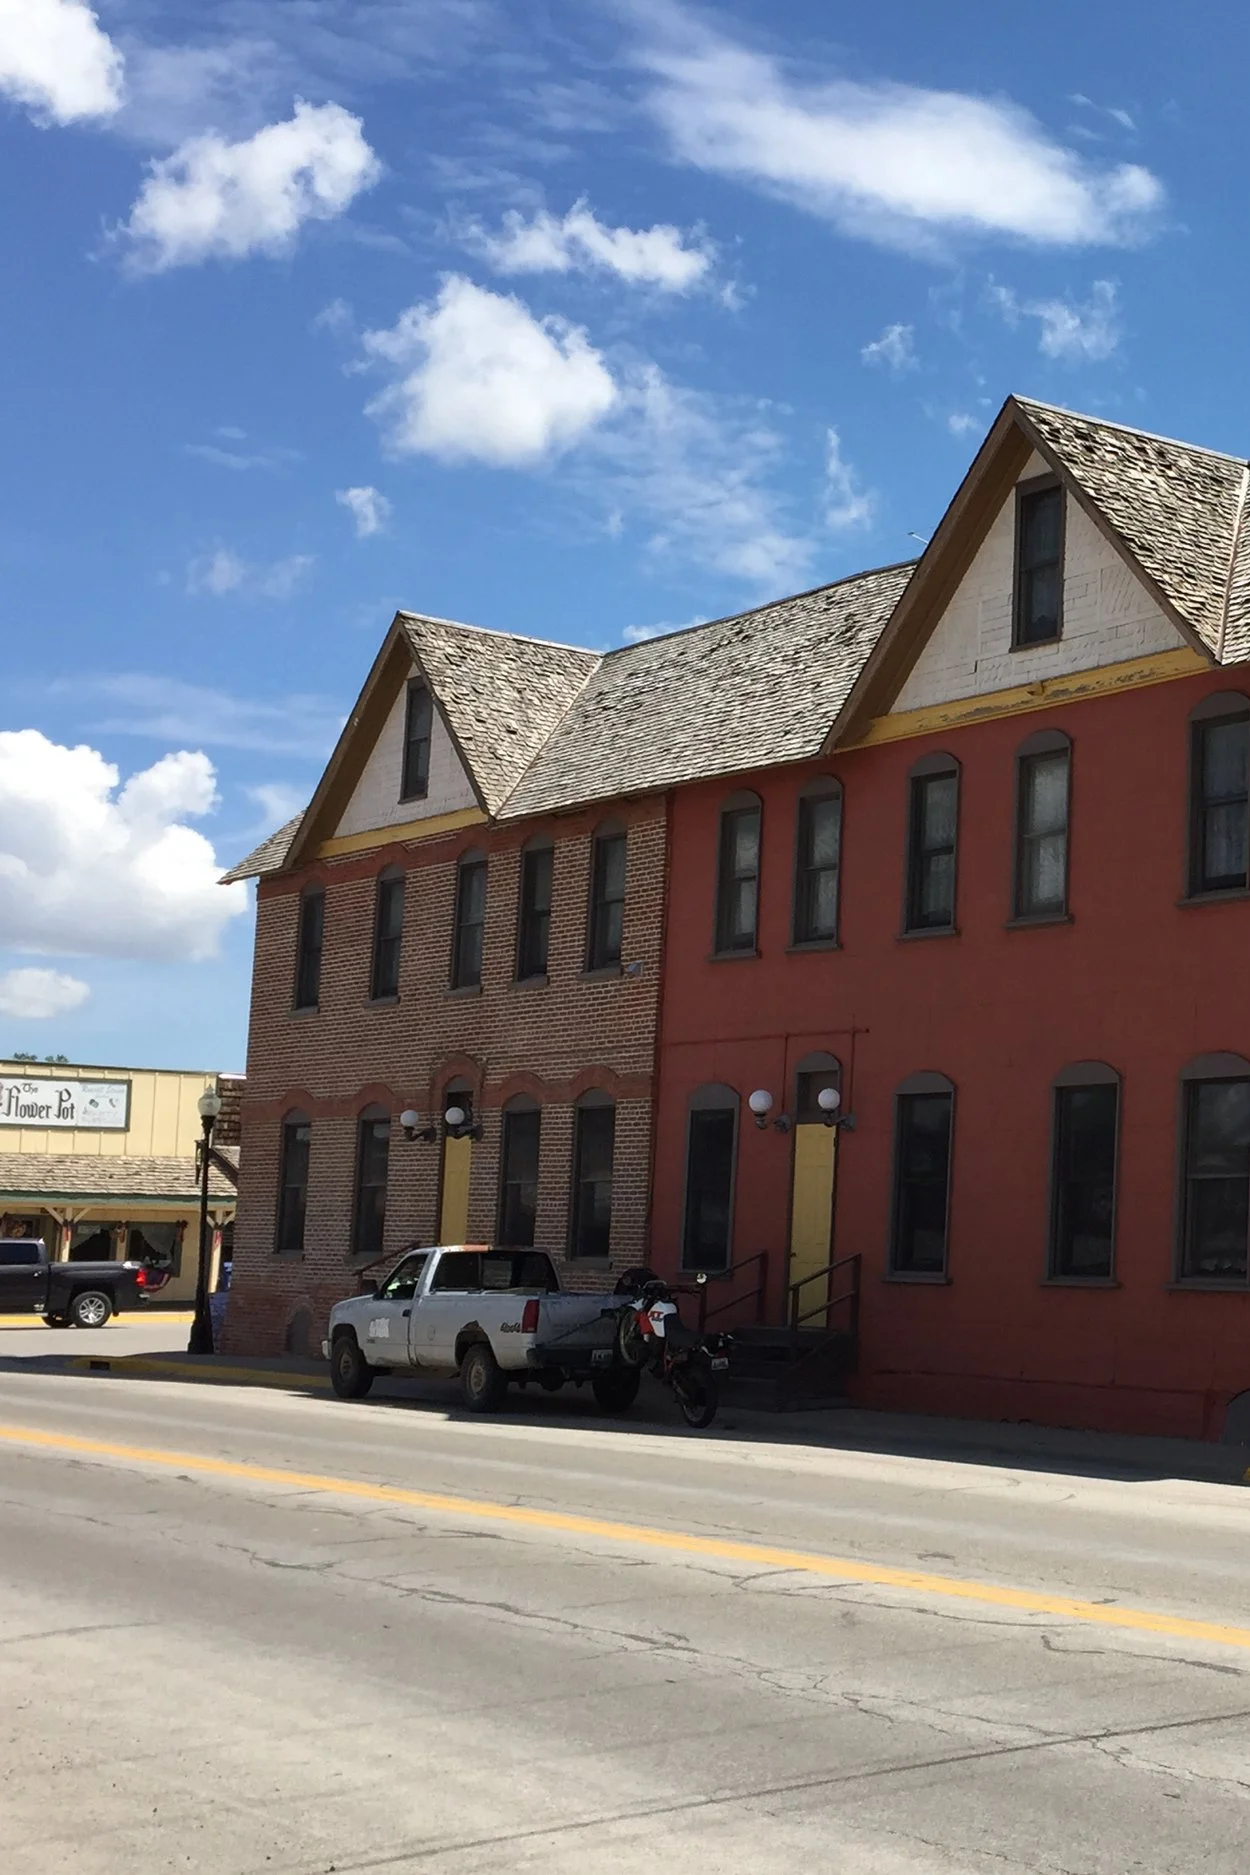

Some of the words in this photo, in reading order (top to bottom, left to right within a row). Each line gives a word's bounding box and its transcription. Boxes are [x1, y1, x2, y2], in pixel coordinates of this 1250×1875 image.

[22, 1083, 39, 1095] The
[2, 1085, 52, 1119] Flower
[54, 1088, 76, 1120] Pot
